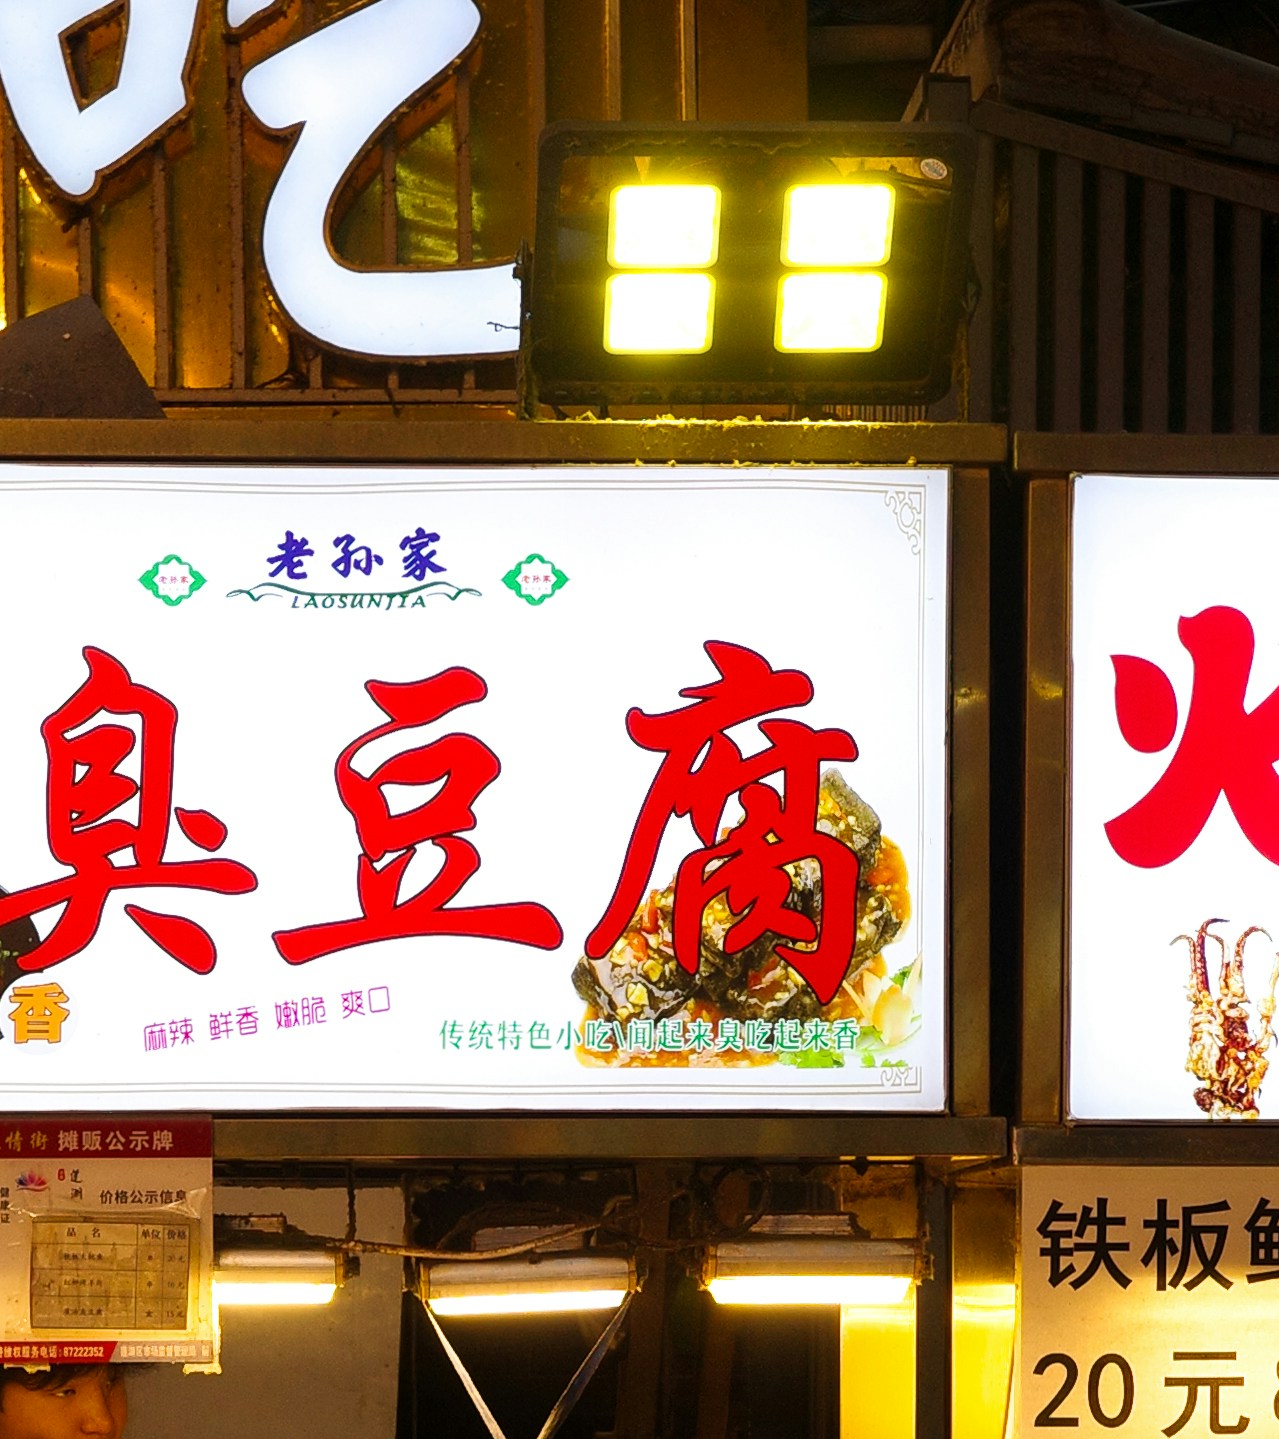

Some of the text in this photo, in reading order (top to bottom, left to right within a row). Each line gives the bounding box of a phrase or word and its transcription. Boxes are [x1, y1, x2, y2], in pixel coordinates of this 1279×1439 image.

[266, 527, 447, 582] 老孙家
[288, 591, 427, 610] LAOSUNJIA
[10, 980, 69, 1044] 香
[143, 1018, 194, 1050] 麻辣
[209, 1005, 260, 1041] 鲜香
[57, 1129, 174, 1152] 摊贩公示牌
[99, 1188, 187, 1207] 价格公示信息
[140, 1226, 162, 1240] 单位
